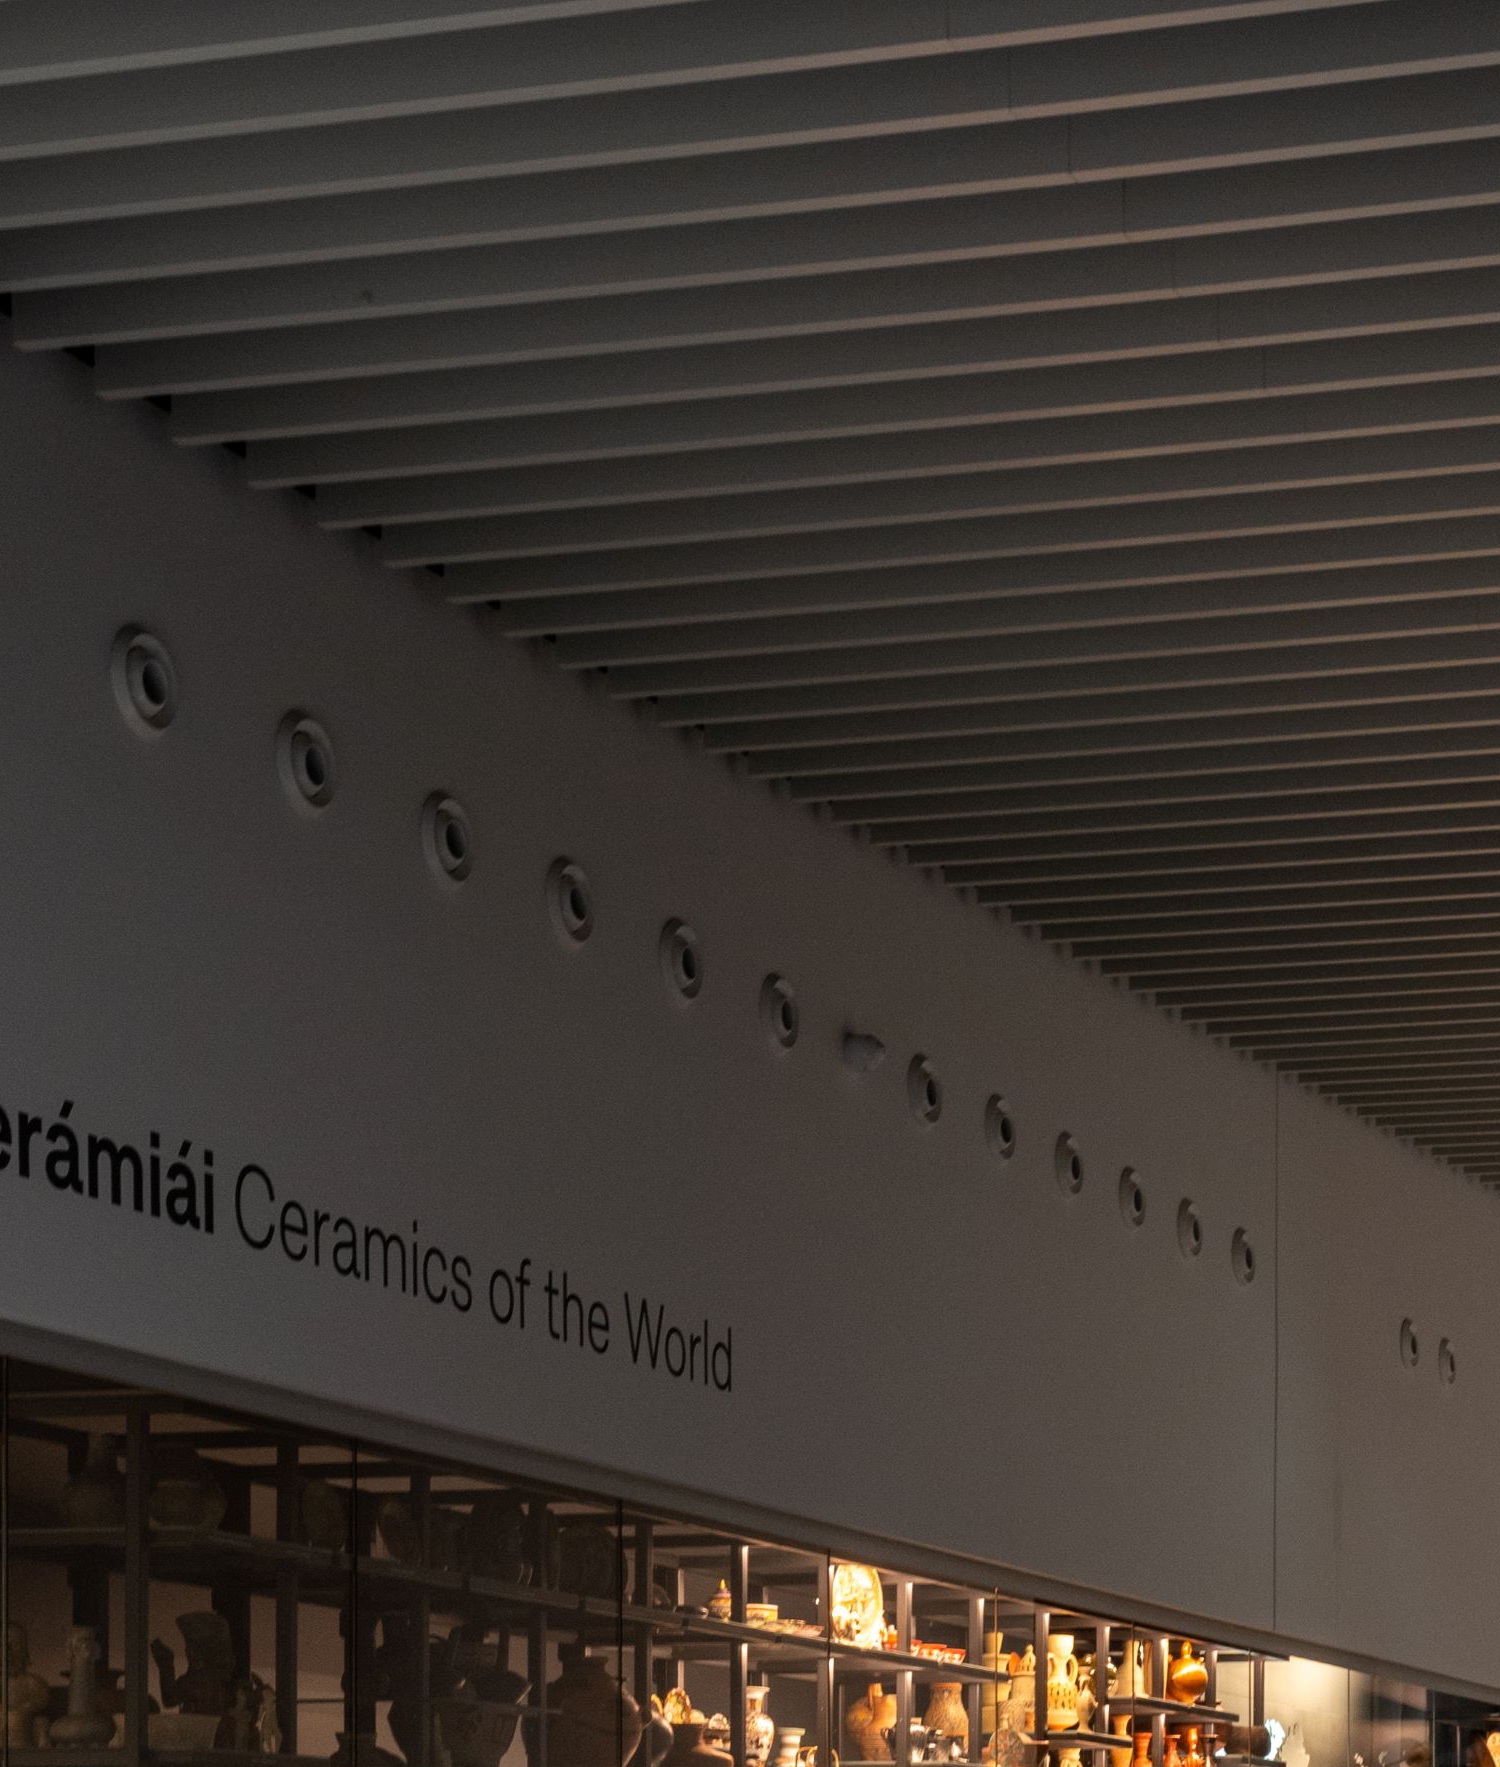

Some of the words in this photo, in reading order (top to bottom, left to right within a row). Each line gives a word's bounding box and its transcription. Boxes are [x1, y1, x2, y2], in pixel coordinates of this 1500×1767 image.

[233, 1162, 474, 1314] Ceramics
[488, 1257, 532, 1330] of
[542, 1269, 611, 1356] the
[623, 1291, 733, 1393] World
